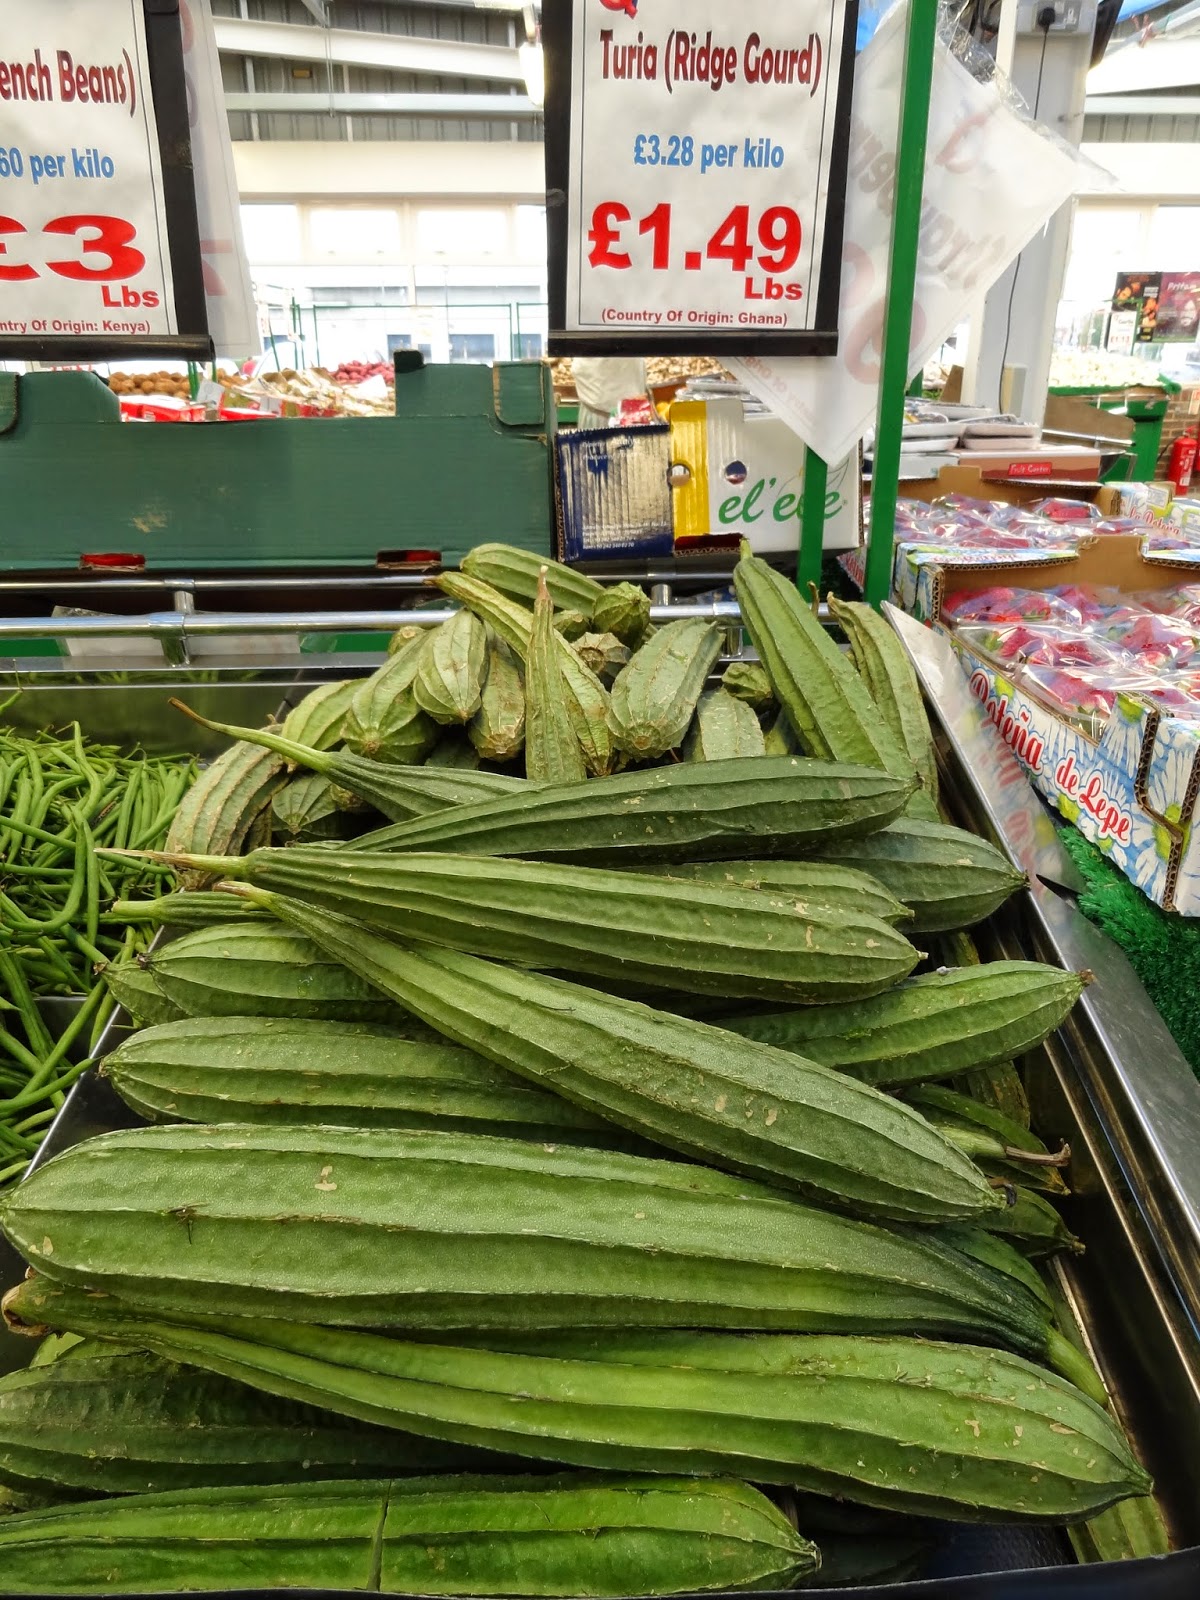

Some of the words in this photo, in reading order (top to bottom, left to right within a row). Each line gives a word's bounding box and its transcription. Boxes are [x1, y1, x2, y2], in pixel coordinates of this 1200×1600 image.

[57, 48, 136, 118] Beans)
[600, 29, 657, 80] Turia
[664, 29, 738, 94] (Ridge
[744, 32, 822, 97] Gourd)
[29, 155, 66, 185] per
[72, 148, 114, 178] kilo
[634, 134, 694, 166] £3.28
[701, 143, 738, 174] per
[743, 138, 784, 168] kilo
[588, 202, 802, 273] £1.49
[101, 285, 160, 307] Lbs
[745, 277, 803, 300] Lbs
[31, 320, 47, 331] Of
[52, 320, 98, 333] Origin:
[103, 320, 150, 333] Kenya)
[602, 308, 661, 325] (Country
[667, 310, 683, 322] Of
[688, 311, 734, 325] Origin:
[738, 312, 788, 327] Ghana)
[717, 477, 843, 524] el'ee
[1056, 757, 1078, 796] de
[1079, 776, 1130, 842] Lepe
